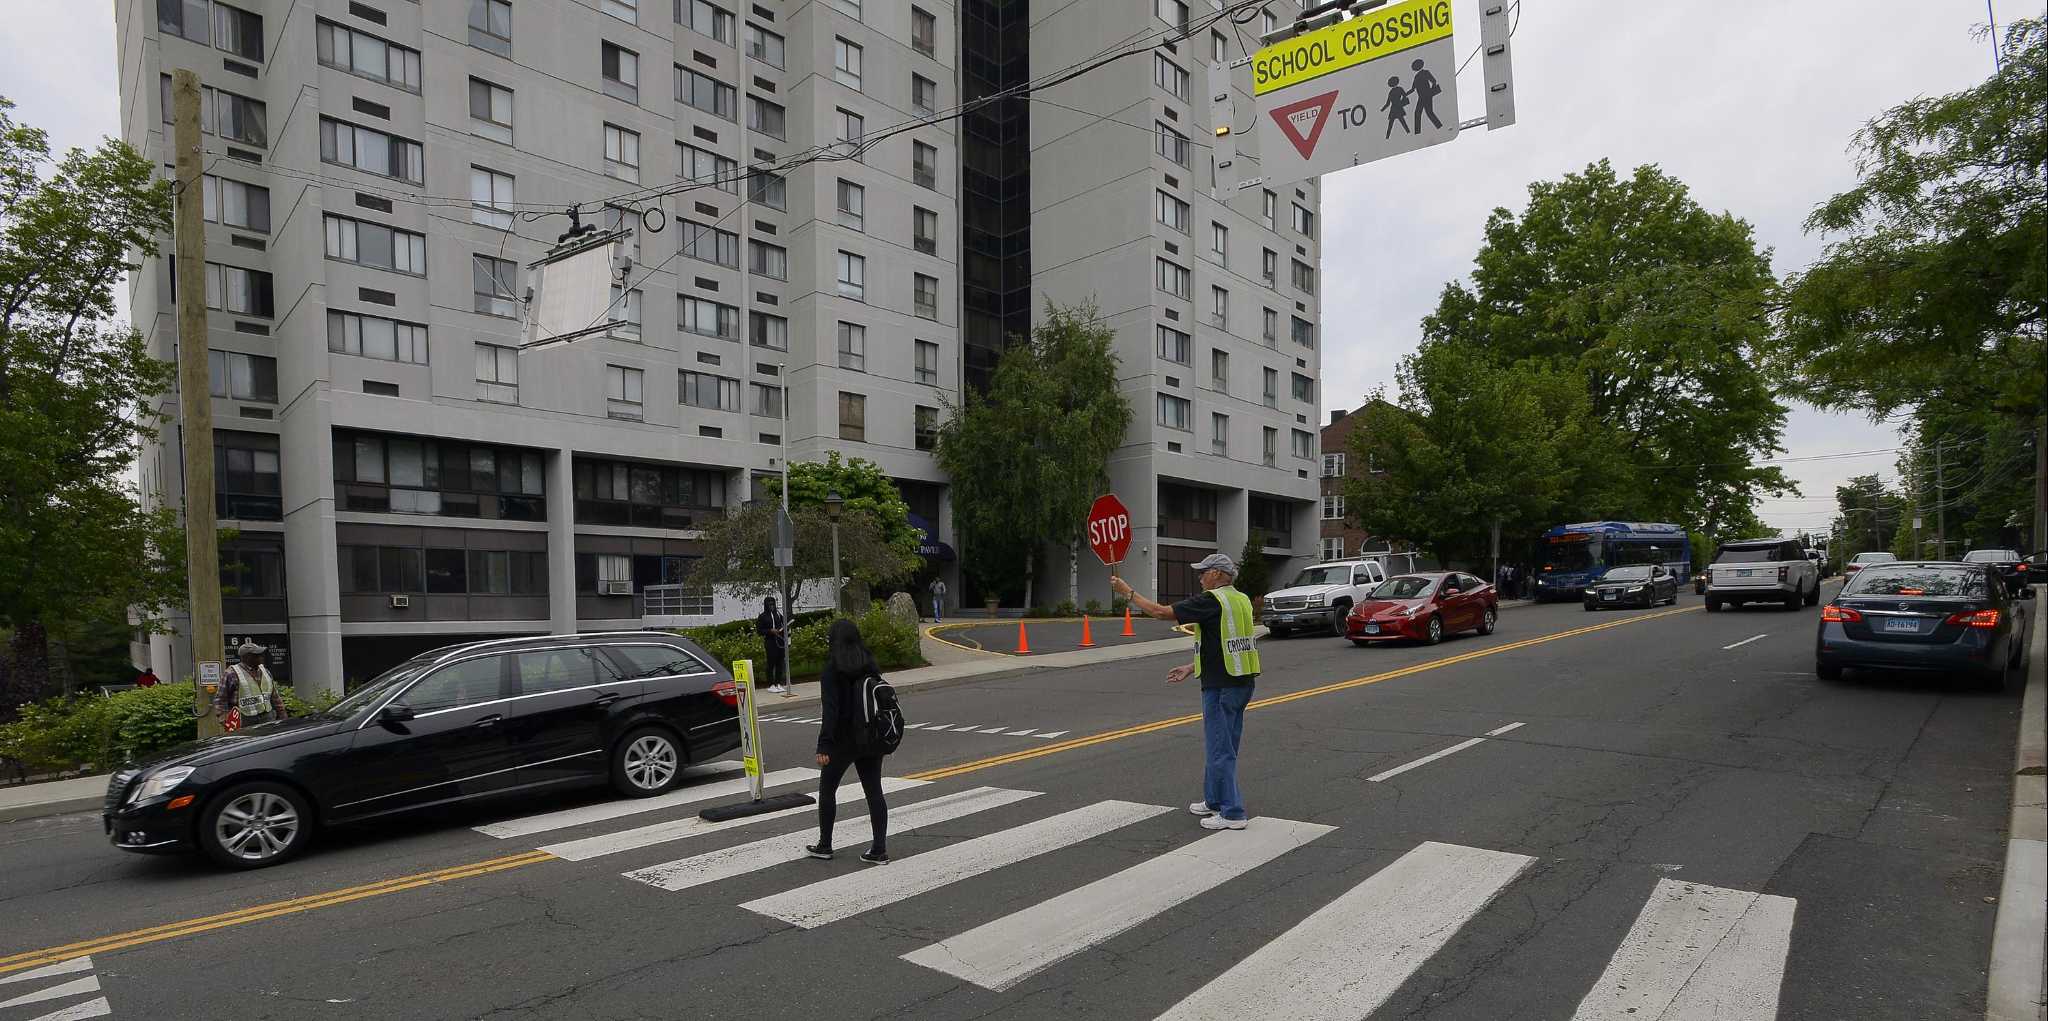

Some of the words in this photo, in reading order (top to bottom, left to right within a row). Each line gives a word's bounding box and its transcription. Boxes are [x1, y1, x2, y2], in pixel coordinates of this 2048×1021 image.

[1256, 39, 1335, 84] SCHOOL
[1342, 1, 1450, 56] CROSSING
[1290, 109, 1318, 123] YIELD
[1337, 104, 1367, 130] TO
[1090, 514, 1128, 546] STOP
